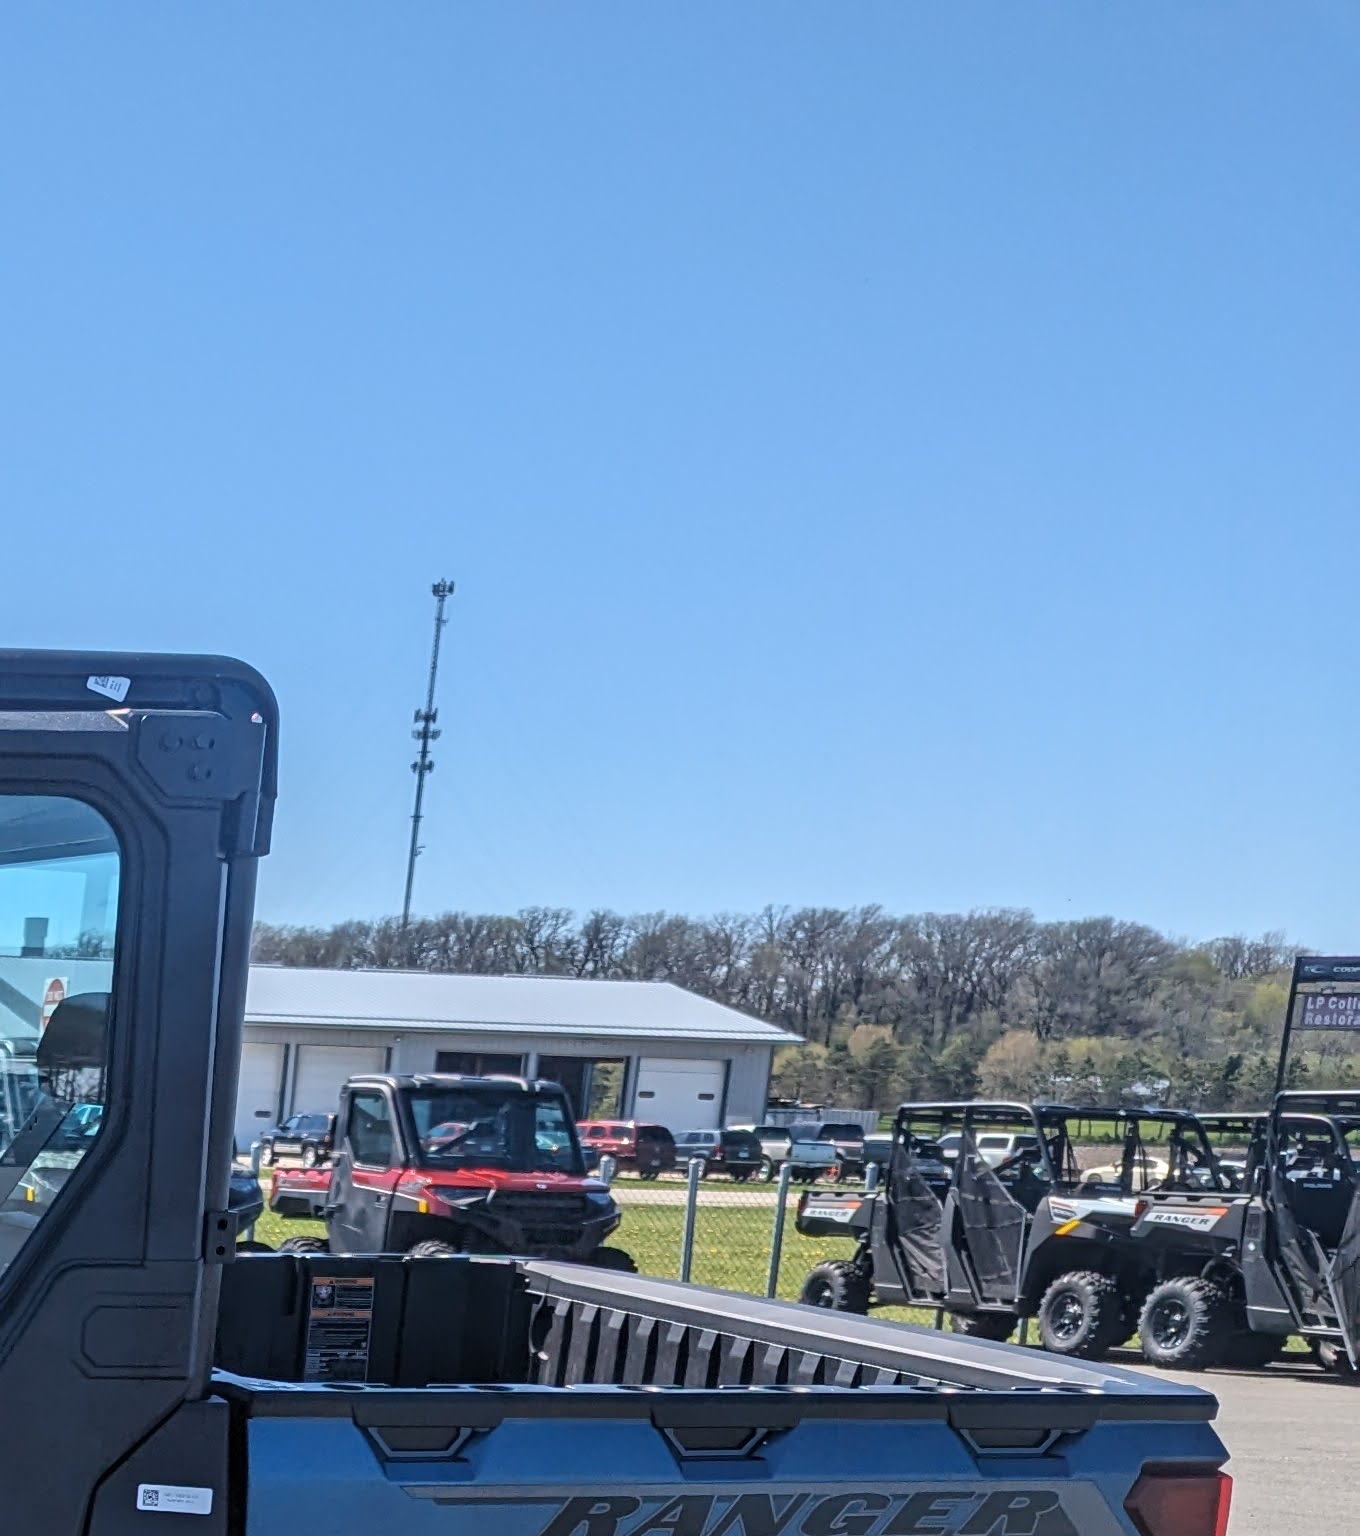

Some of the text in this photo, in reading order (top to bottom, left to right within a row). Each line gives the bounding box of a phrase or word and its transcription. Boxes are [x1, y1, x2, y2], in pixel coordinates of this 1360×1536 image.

[1306, 996, 1326, 1010] LP
[809, 1209, 850, 1218] RANGER
[1153, 1213, 1211, 1226] RANGER
